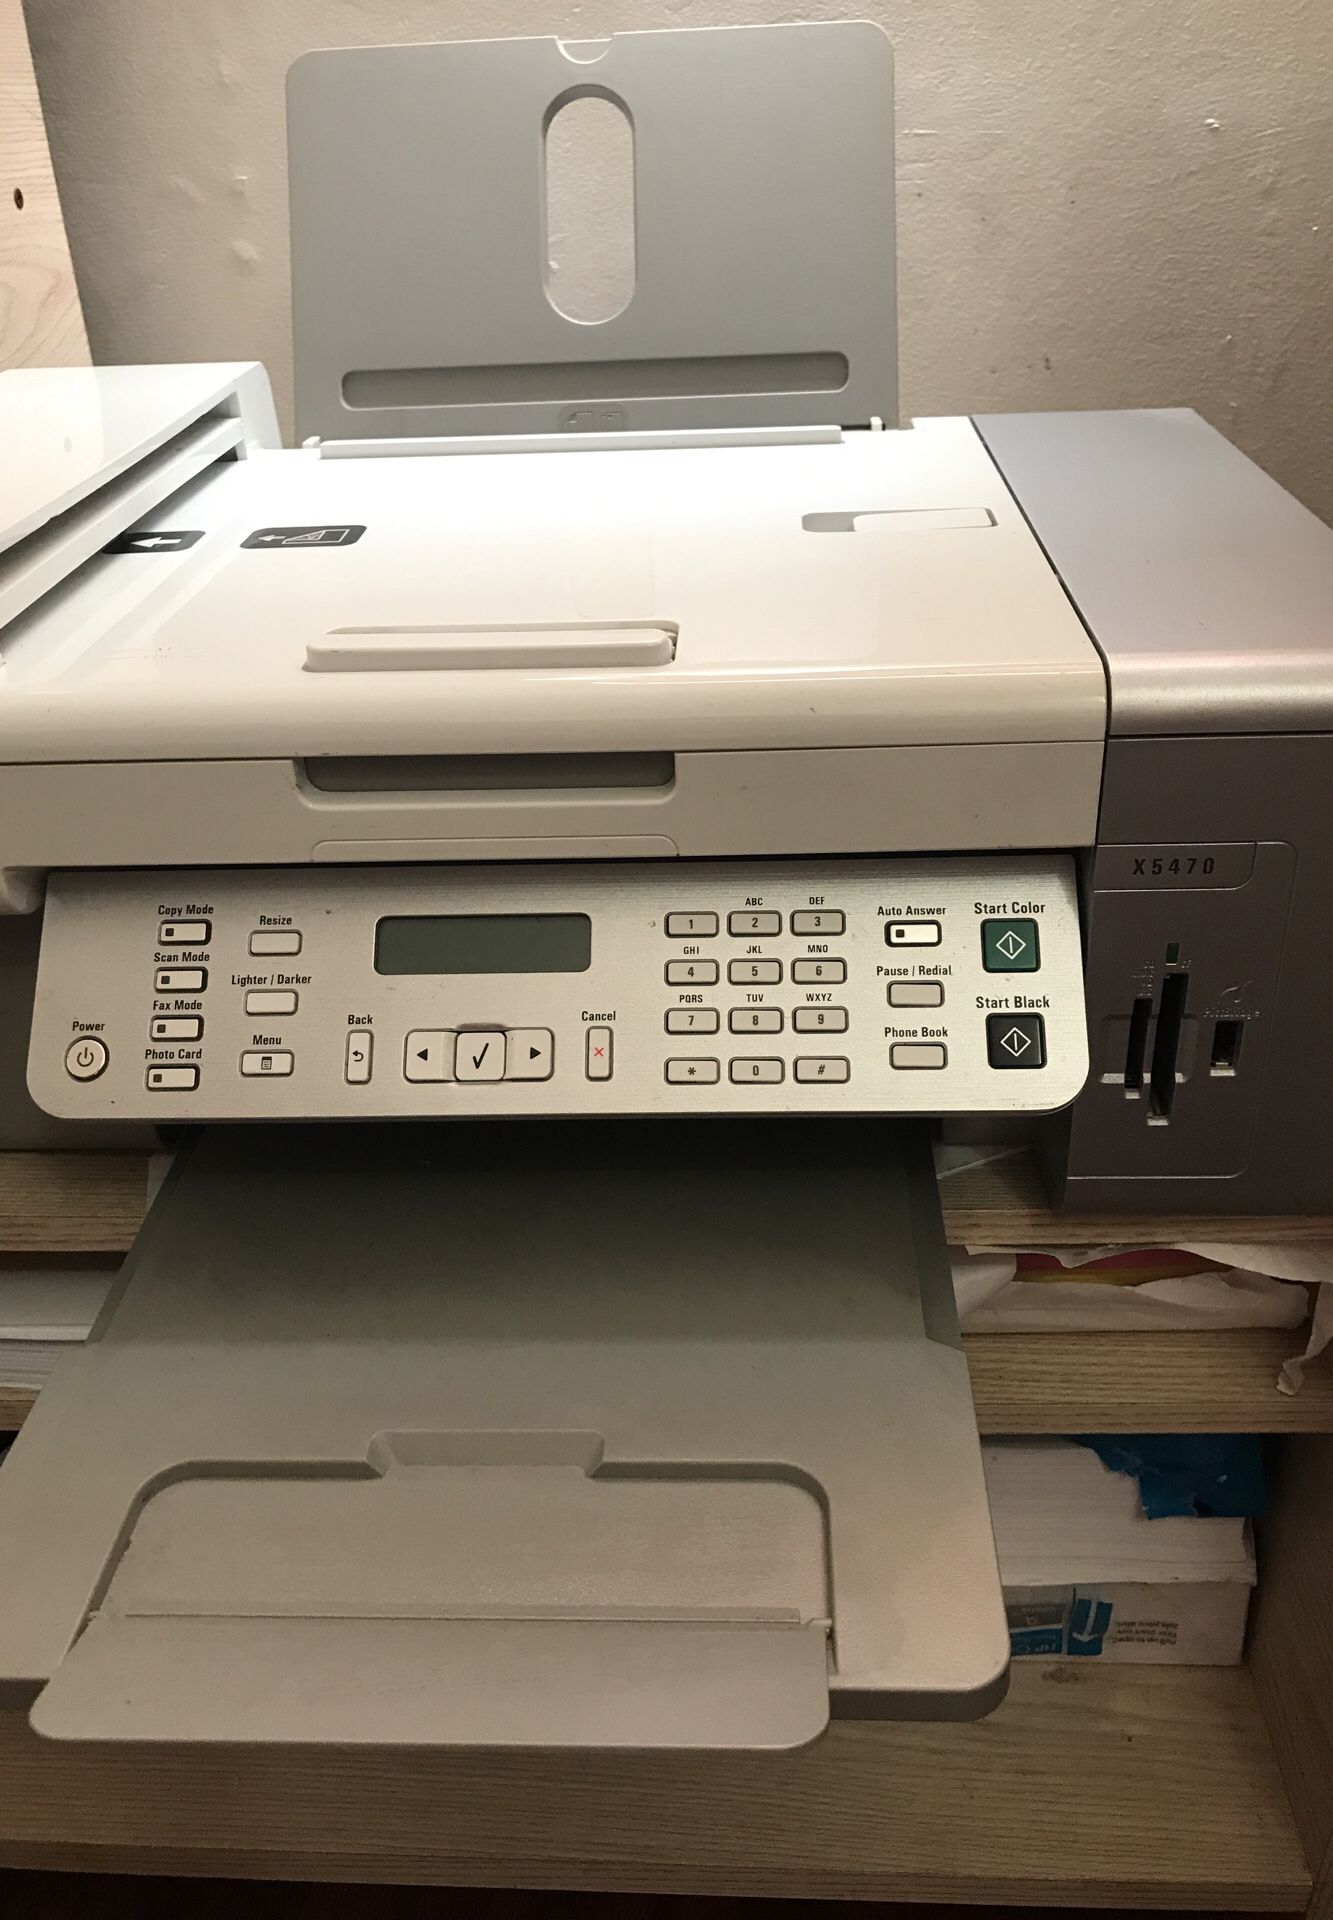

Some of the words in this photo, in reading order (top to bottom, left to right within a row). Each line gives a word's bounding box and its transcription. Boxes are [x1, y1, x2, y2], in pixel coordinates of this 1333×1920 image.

[1131, 857, 1215, 875] X5470
[745, 897, 764, 906] ABC
[809, 896, 825, 905] DEF
[157, 905, 183, 917] Copy
[186, 904, 214, 915] Mode
[877, 905, 902, 916] Auto
[905, 905, 947, 916] Answer
[974, 902, 1007, 915] Start
[1011, 901, 1046, 914] Color
[259, 915, 293, 926] Resize
[688, 919, 694, 930] 1
[751, 917, 759, 928] 2
[814, 916, 821, 927] 3
[683, 946, 700, 955] GHI
[746, 945, 763, 954] JKL
[807, 944, 829, 953] MNO
[153, 952, 179, 963] Scan
[182, 951, 210, 963] Mode
[687, 966, 695, 977] 4
[751, 966, 758, 977] 5
[816, 965, 823, 976] 6
[876, 965, 909, 977] Pause
[911, 965, 915, 977] /
[918, 965, 952, 976] Redial
[231, 974, 268, 987] Lighter
[270, 974, 275, 986] /
[277, 974, 312, 985] Darker
[679, 994, 703, 1004] PQRS
[746, 994, 764, 1003] TUV
[805, 993, 833, 1002] WXYZ
[976, 996, 1010, 1009] Start
[1014, 995, 1050, 1008] Black
[152, 1001, 172, 1011] Fax
[174, 1000, 203, 1010] Mode
[347, 1014, 373, 1026] Back
[581, 1010, 616, 1022] Cancel
[688, 1015, 695, 1026] 7
[752, 1015, 759, 1026] 8
[817, 1014, 824, 1025] 9
[72, 1021, 105, 1032] Power
[884, 1027, 918, 1038] Phone
[922, 1026, 949, 1038] Book
[252, 1035, 282, 1046] Menu
[144, 1049, 175, 1060] Photo
[178, 1048, 203, 1059] Card
